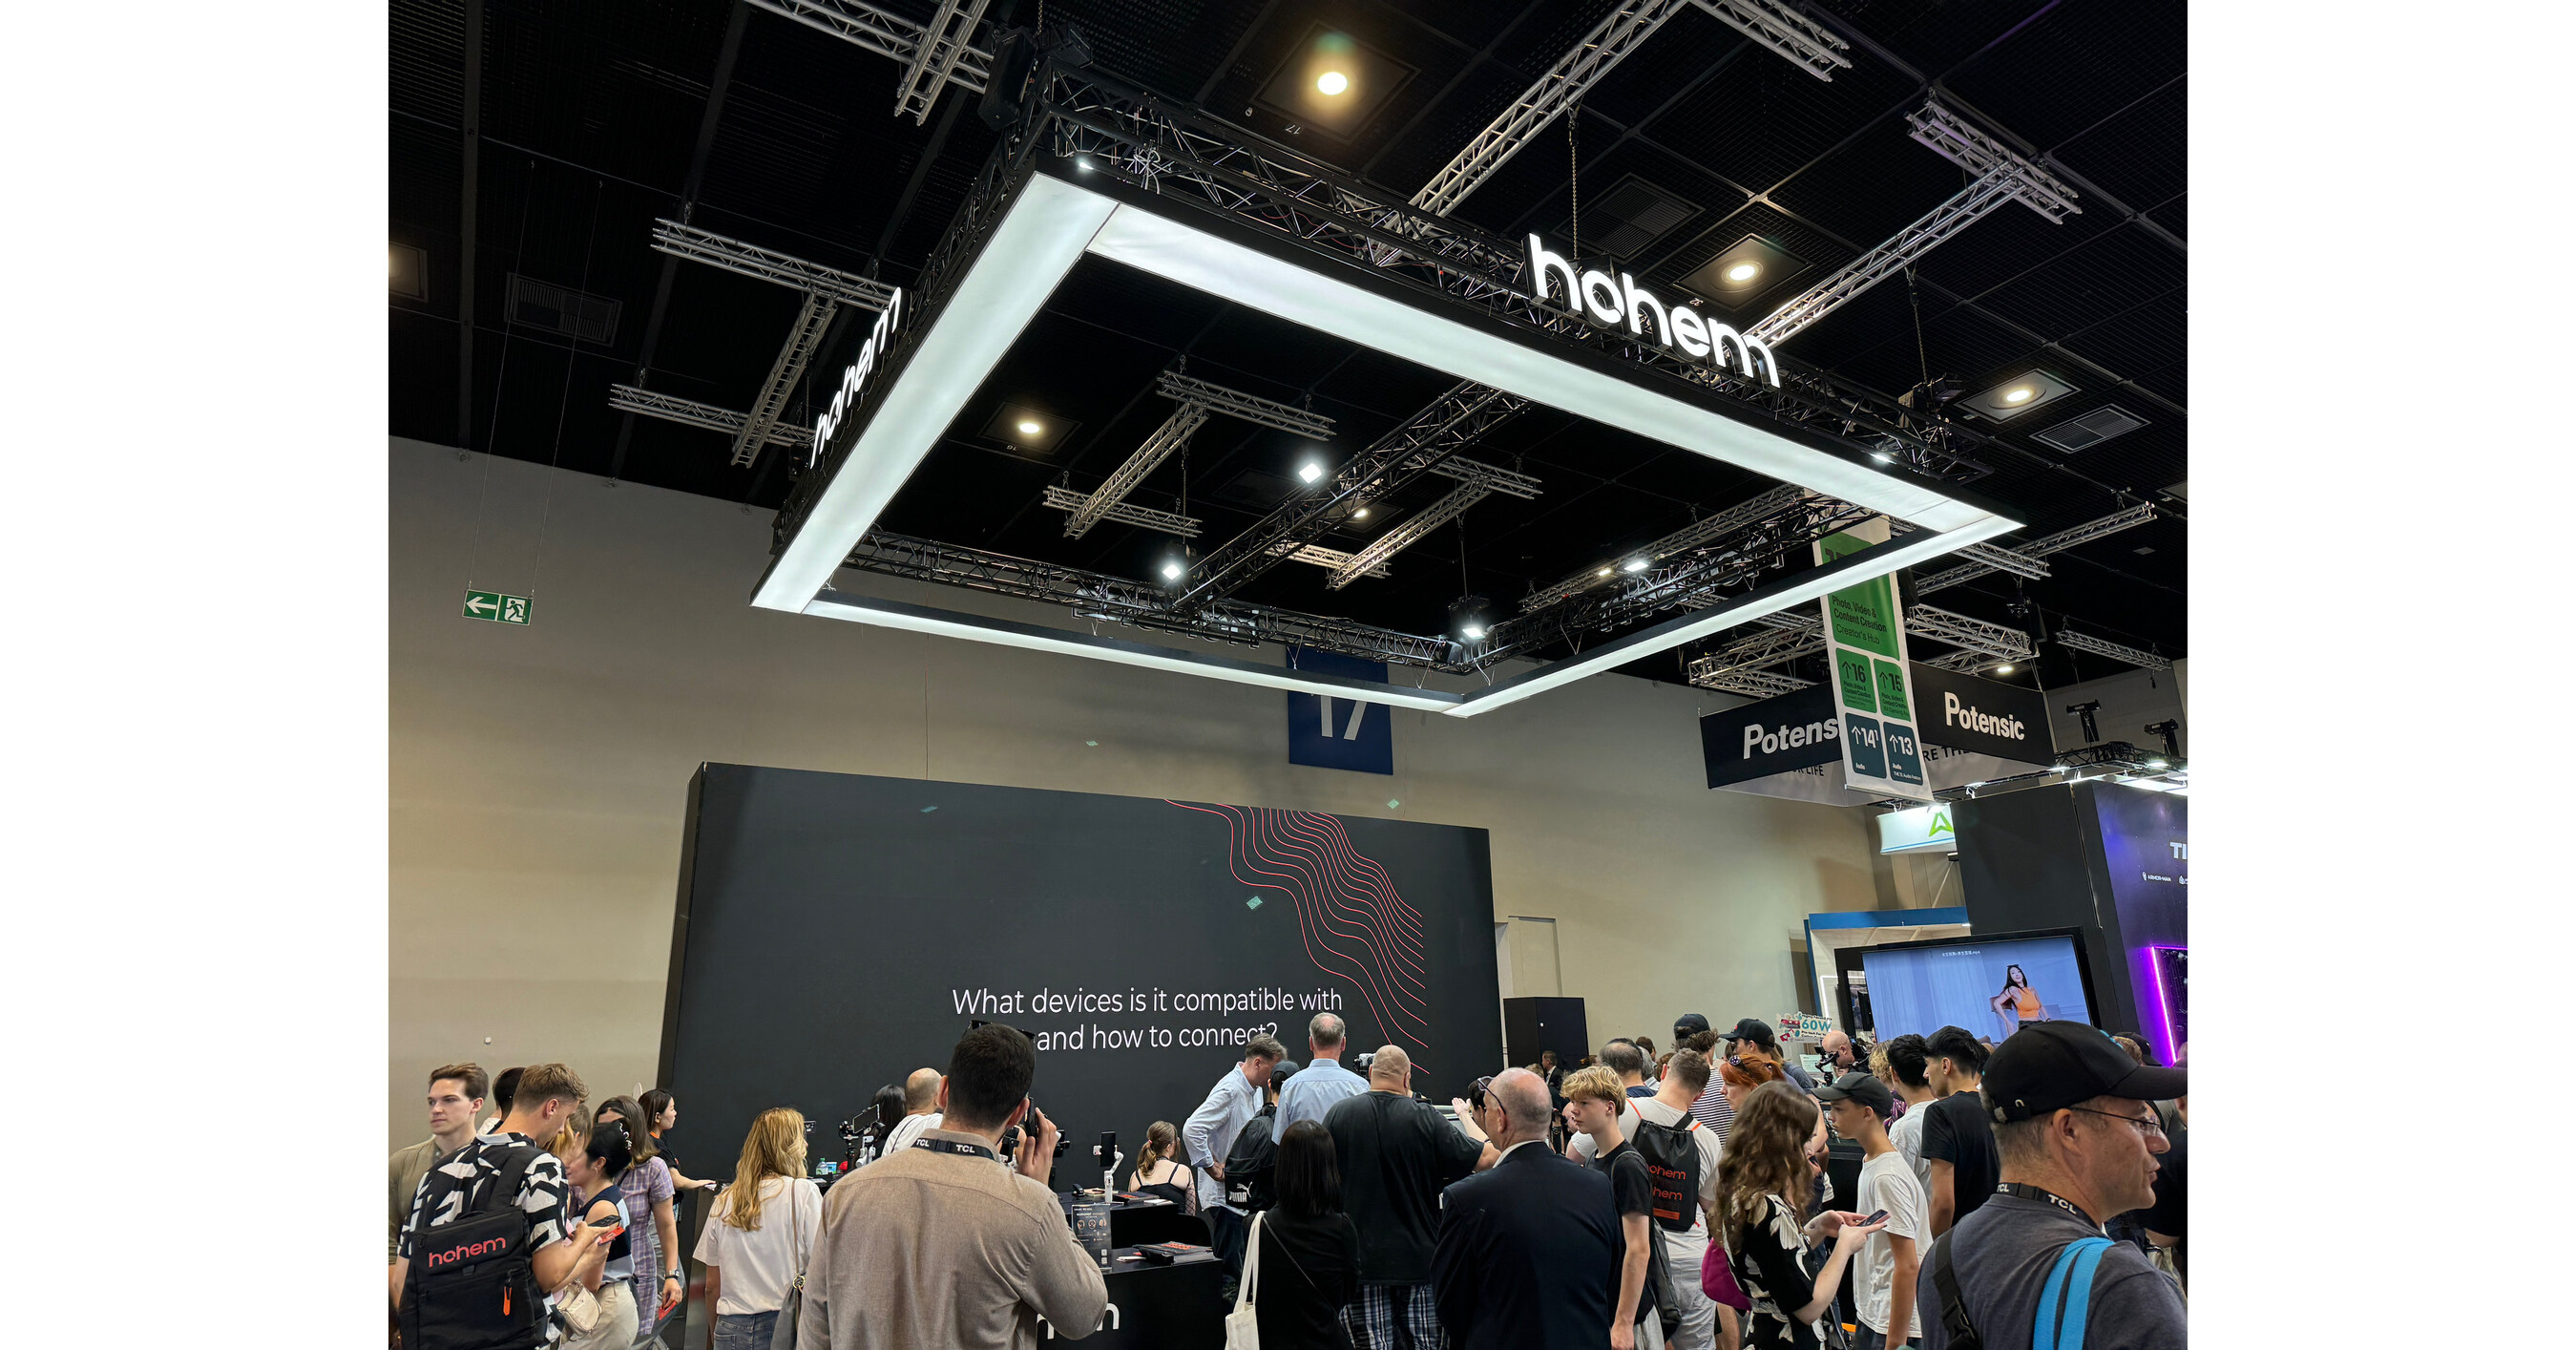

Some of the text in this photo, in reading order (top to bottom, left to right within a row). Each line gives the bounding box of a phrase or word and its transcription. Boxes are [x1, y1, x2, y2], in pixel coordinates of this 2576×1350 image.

[1528, 232, 1780, 389] hohem
[810, 286, 902, 469] hohem
[1853, 601, 1871, 617] Video
[1833, 608, 1888, 633] Content Creation
[1835, 623, 1880, 644] Creator's Hub
[1852, 663, 1867, 684] 16
[1888, 672, 1903, 693] 15
[1944, 691, 2025, 741] Potensic
[1743, 718, 1839, 760] Potens
[1897, 735, 1914, 756] 13
[1806, 765, 1824, 777] LIFE
[952, 986, 1342, 1017] What devices is it compatible with
[1802, 1019, 1832, 1032] 60W
[1037, 1022, 1278, 1051] and how to connect?
[955, 1144, 975, 1153] TCL
[1647, 1164, 1686, 1180] ohem
[2047, 1193, 2077, 1214] TCL
[429, 1236, 506, 1268] hohem
